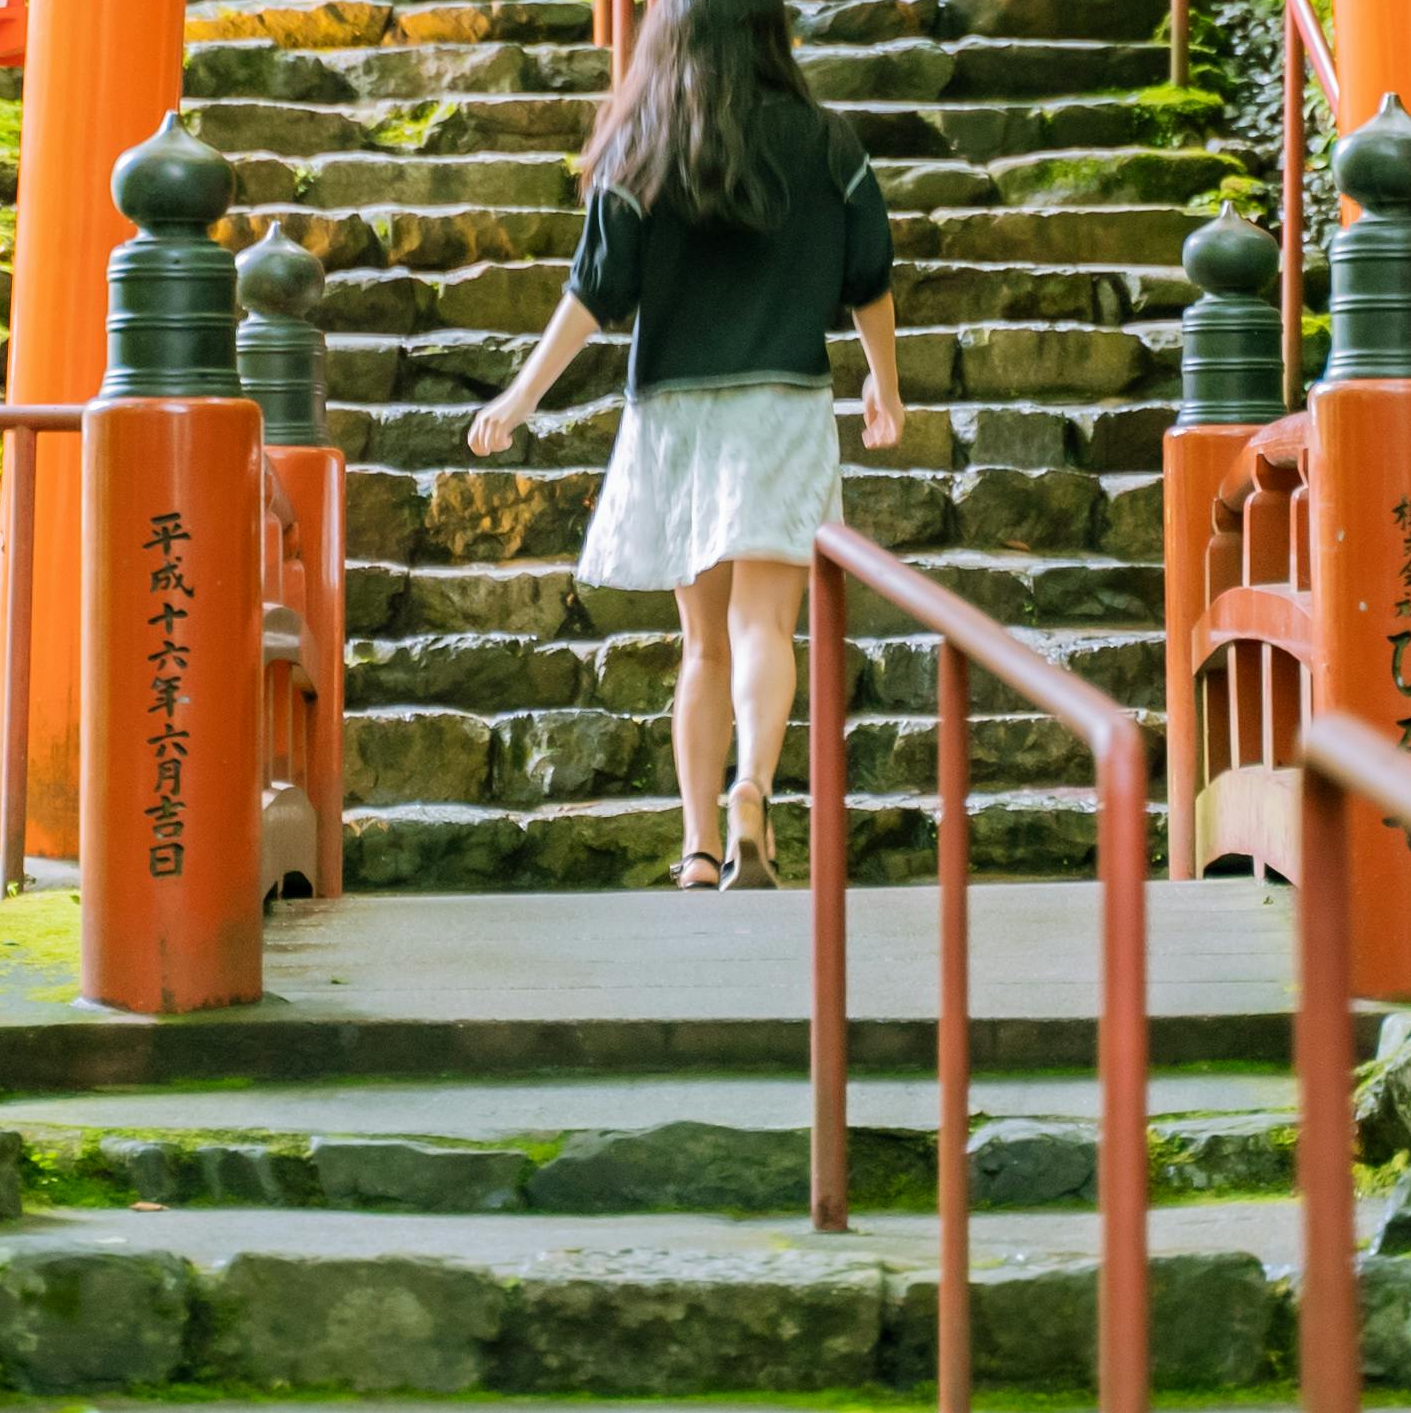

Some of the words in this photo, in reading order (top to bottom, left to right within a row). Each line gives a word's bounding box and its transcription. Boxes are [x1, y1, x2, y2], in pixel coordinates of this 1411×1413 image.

[142, 512, 195, 878] 平成十六年六月吉日
